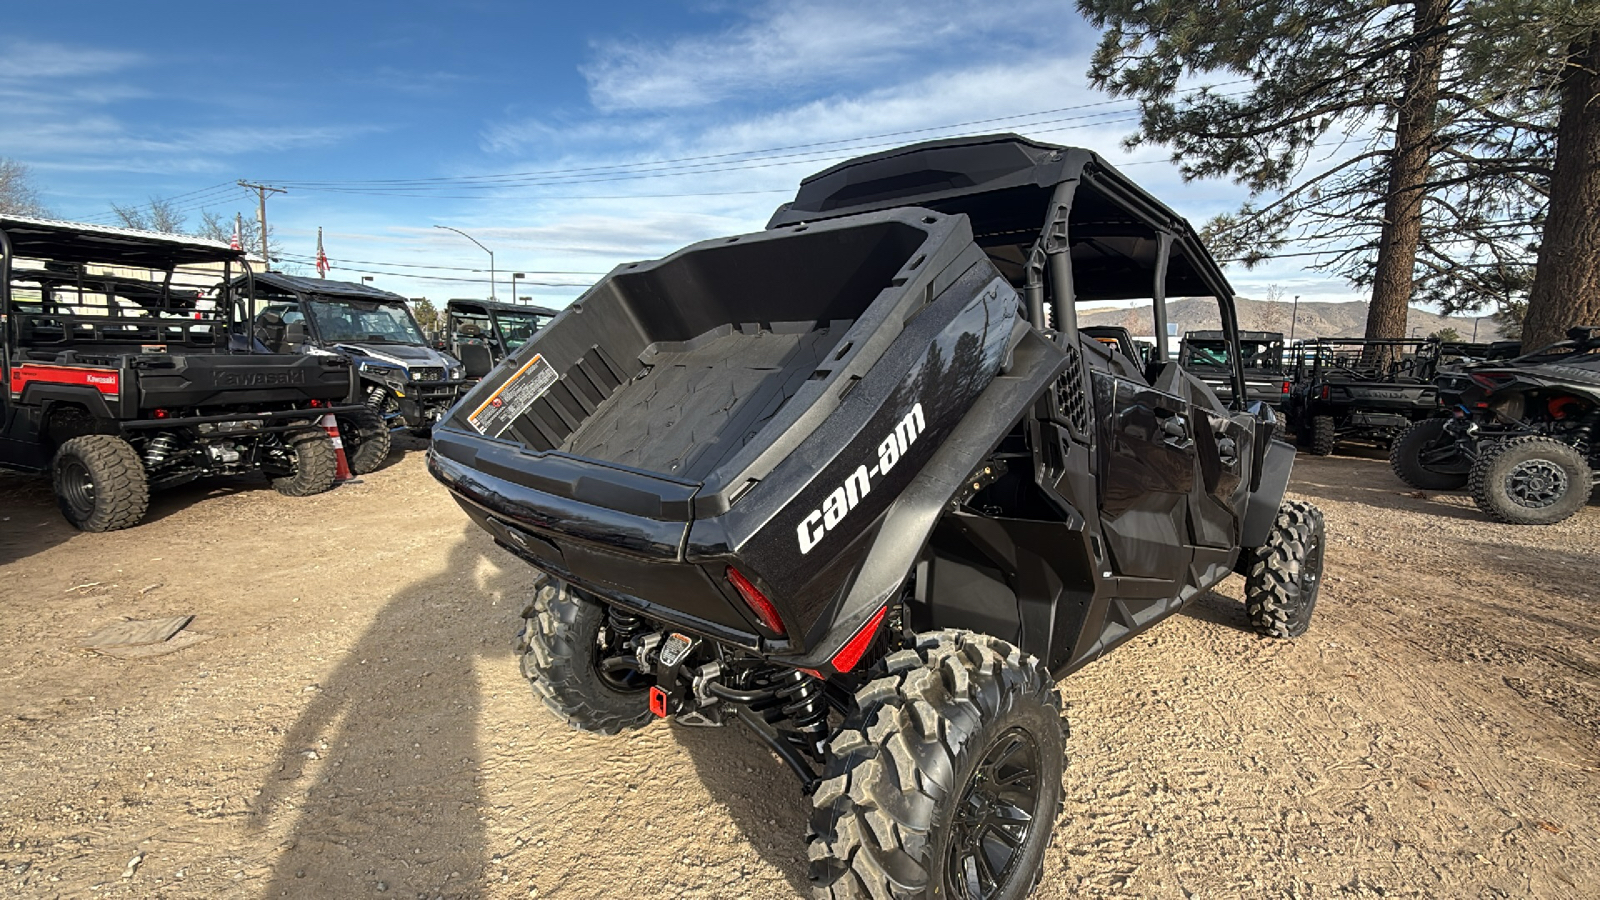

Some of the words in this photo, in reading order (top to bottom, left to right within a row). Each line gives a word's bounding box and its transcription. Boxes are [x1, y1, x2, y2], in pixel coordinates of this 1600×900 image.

[86, 374, 116, 384] Kawasaki
[210, 369, 305, 387] Kawasaki
[797, 403, 926, 554] can-am
